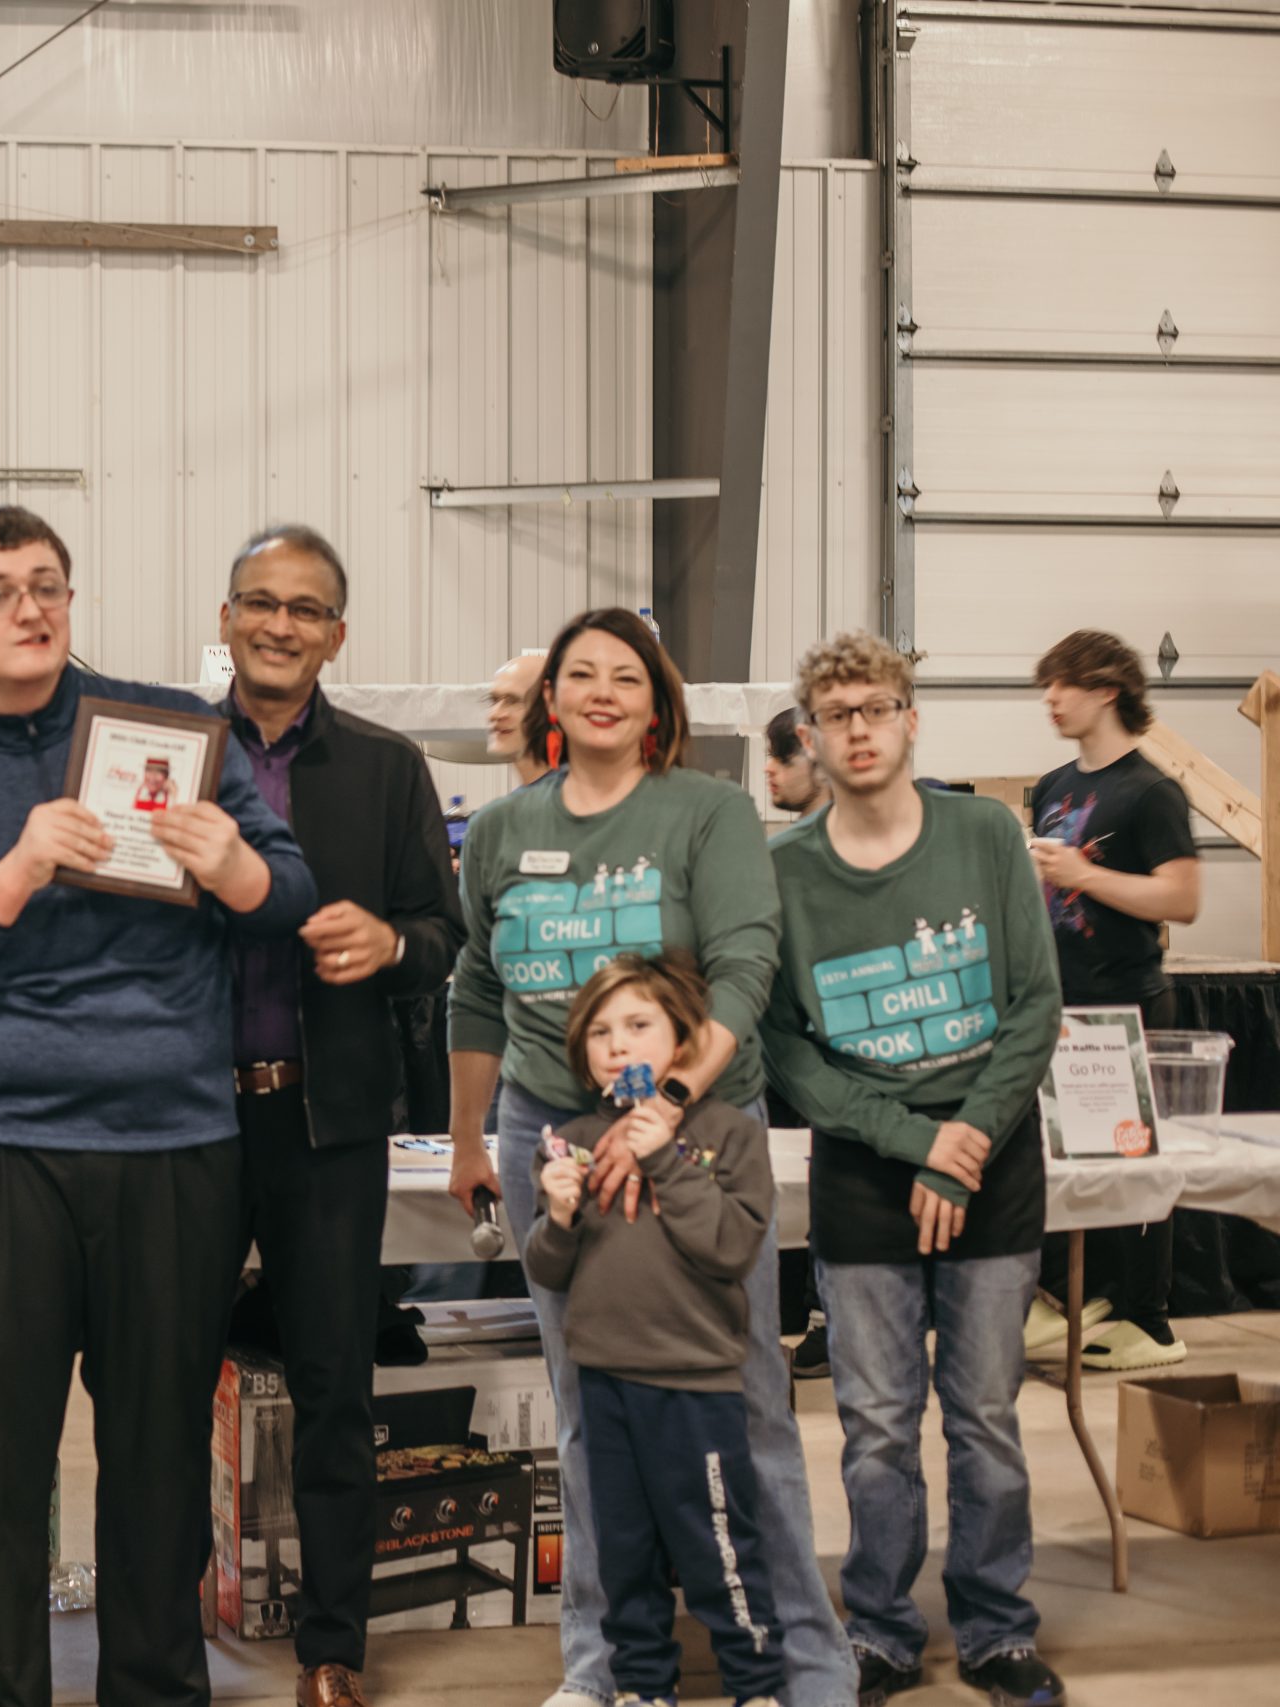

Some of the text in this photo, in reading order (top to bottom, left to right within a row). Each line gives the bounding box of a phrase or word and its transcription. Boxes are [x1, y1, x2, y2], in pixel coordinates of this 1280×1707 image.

[540, 917, 601, 941] CHILI
[501, 959, 564, 984] COOK
[882, 981, 948, 1015] CHILI
[944, 1012, 985, 1042] OFF
[1072, 1043, 1101, 1052] Raffle
[1103, 1043, 1126, 1051] Item
[1069, 1062, 1116, 1076] Go Pro
[385, 1524, 474, 1552] BLACKSTONE
